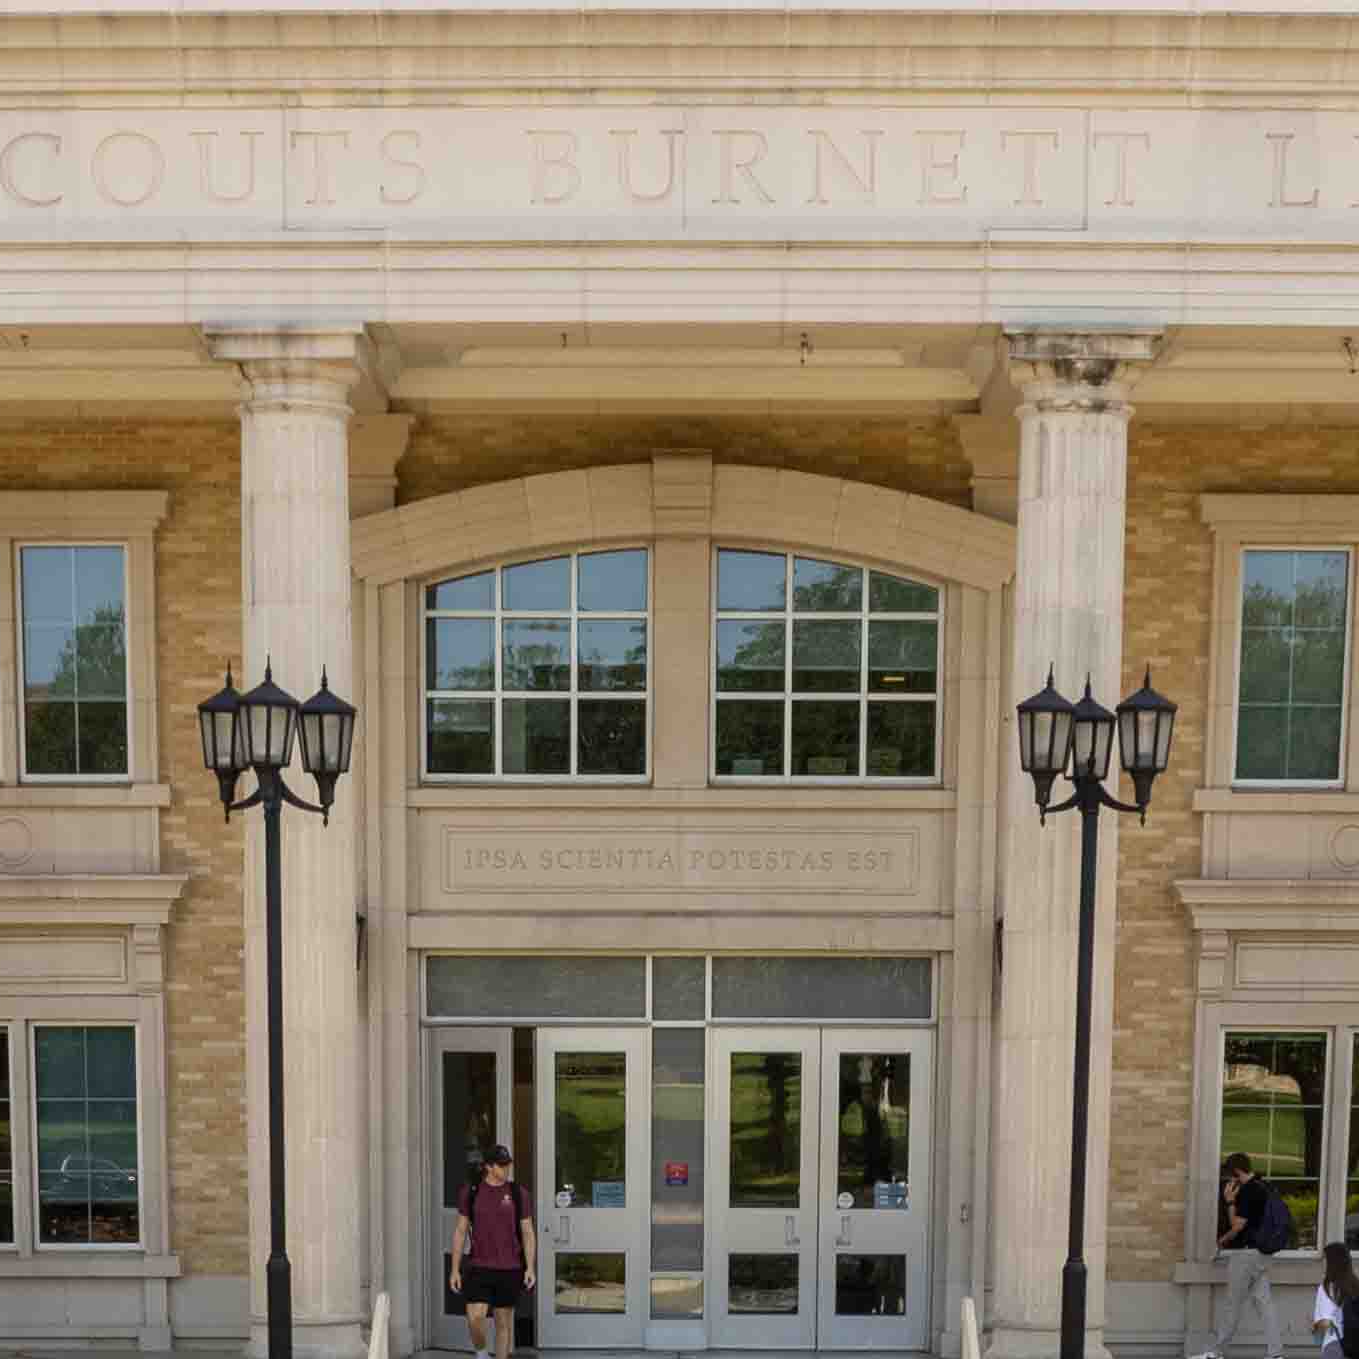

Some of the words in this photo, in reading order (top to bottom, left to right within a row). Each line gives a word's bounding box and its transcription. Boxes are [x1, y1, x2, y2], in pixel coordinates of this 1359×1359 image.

[524, 128, 1151, 209] BURNETT
[463, 847, 528, 872] IPSA
[539, 848, 675, 873] SCIENTIA
[688, 849, 833, 873] POTESTAS
[847, 849, 895, 873] EST
